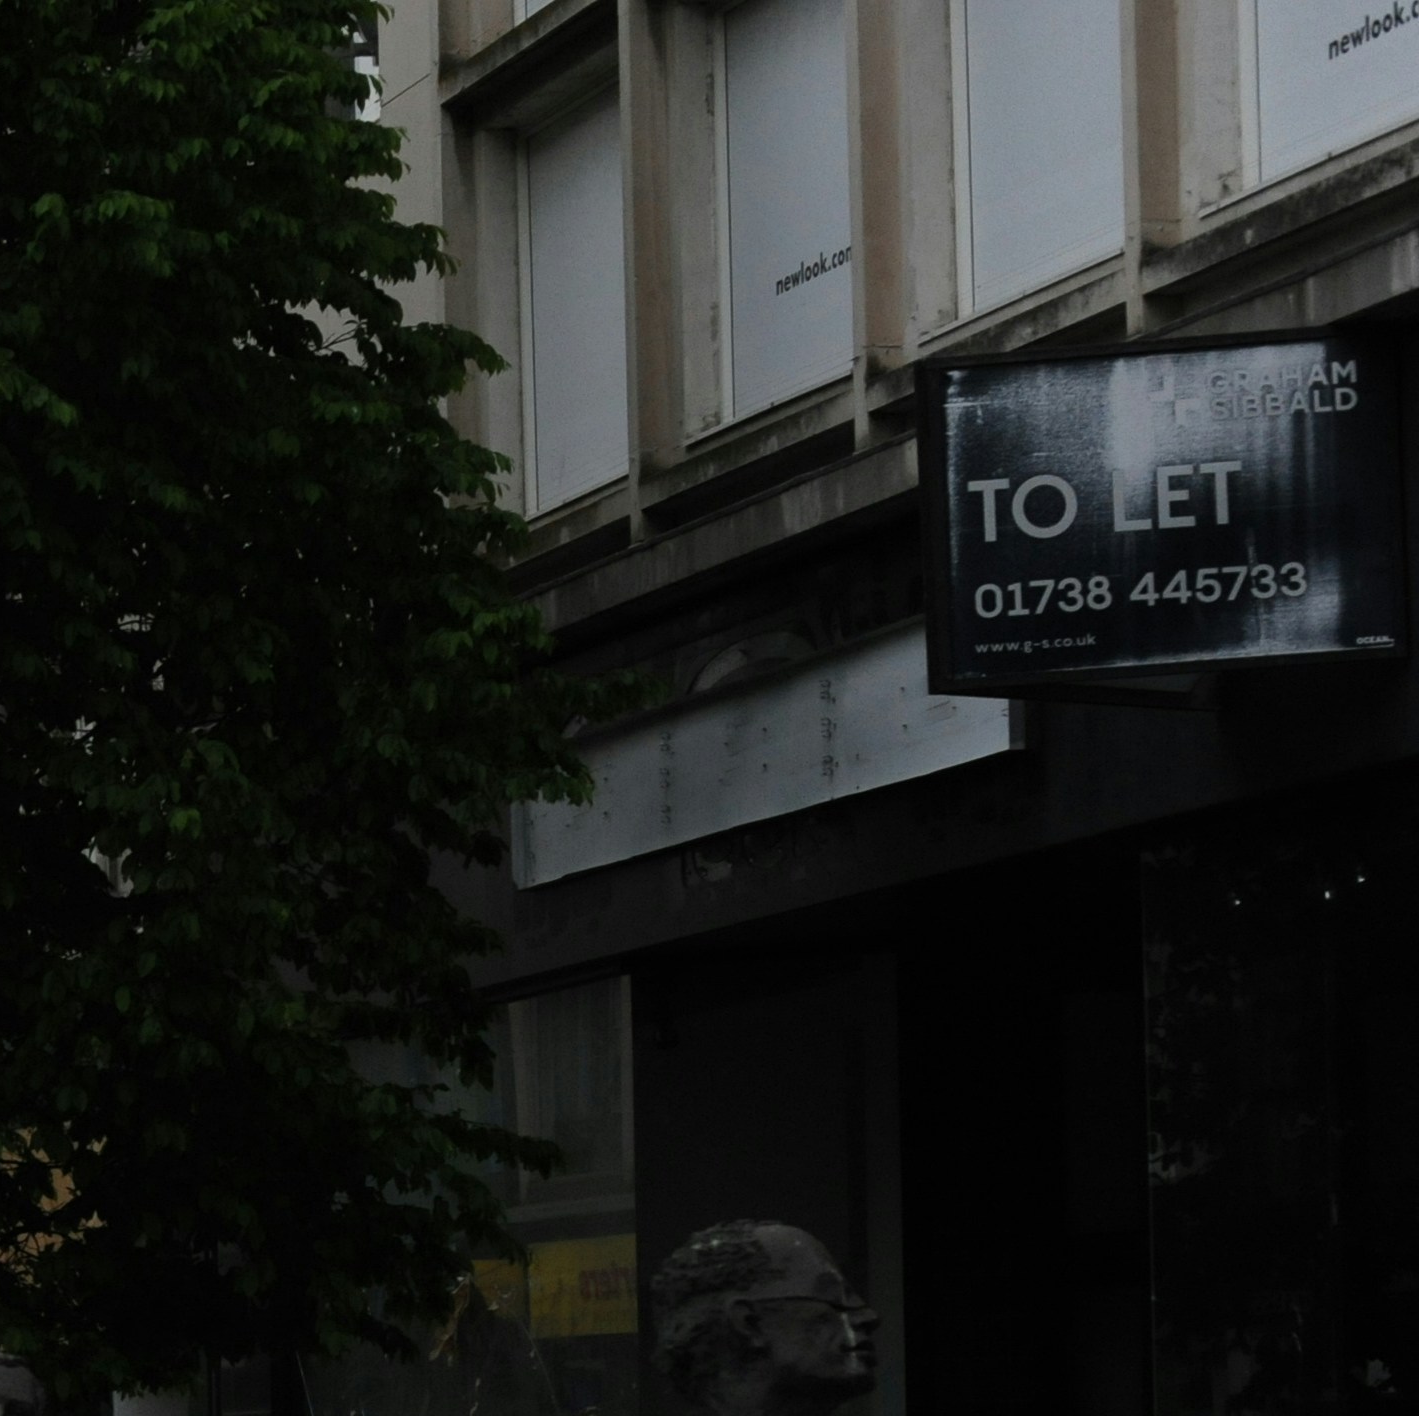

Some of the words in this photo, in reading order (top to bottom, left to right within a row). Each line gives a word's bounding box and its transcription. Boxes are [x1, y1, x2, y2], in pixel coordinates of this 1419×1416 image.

[1212, 360, 1358, 394] GRAHAM
[1213, 388, 1359, 421] SIBBALD
[967, 474, 1078, 542] TO
[1114, 460, 1242, 533] LET
[974, 575, 1113, 619] 01738
[1129, 561, 1308, 607] 445733
[974, 632, 1097, 654] www.g-s.co.uk
